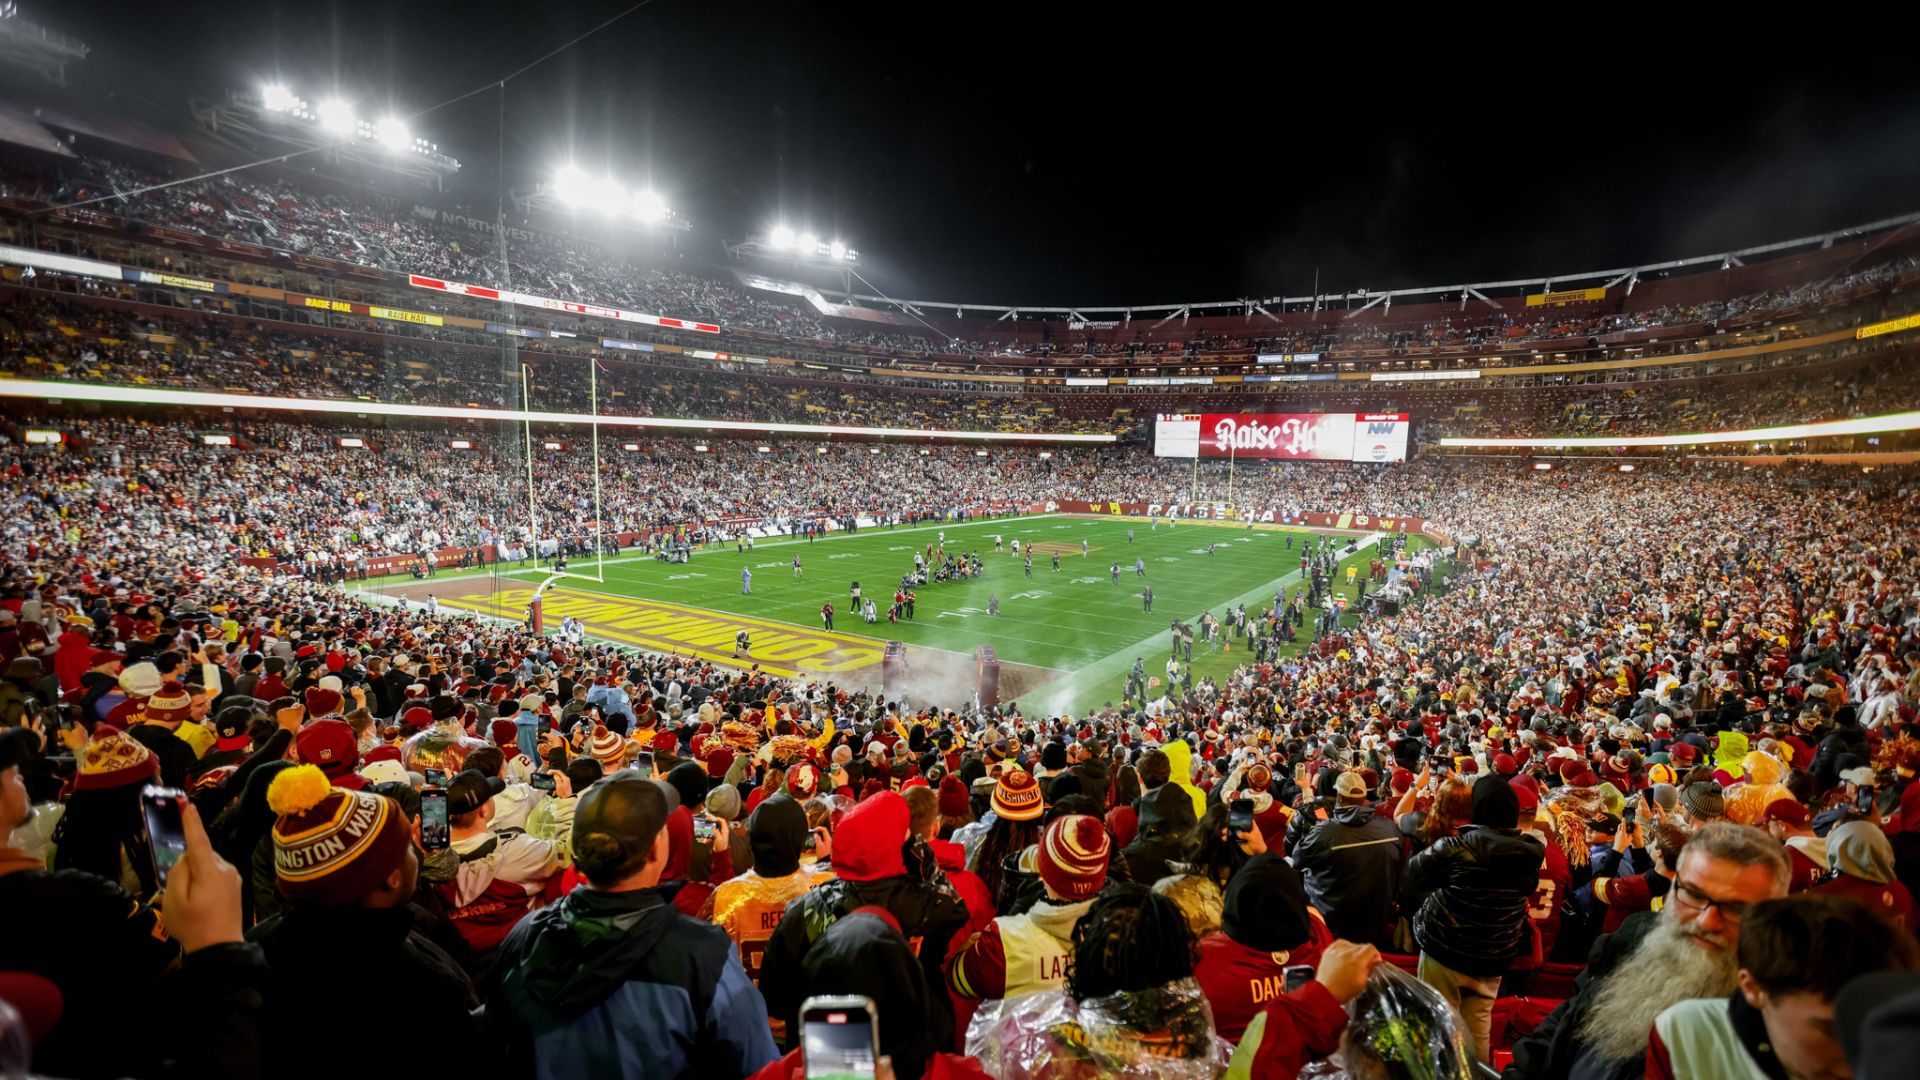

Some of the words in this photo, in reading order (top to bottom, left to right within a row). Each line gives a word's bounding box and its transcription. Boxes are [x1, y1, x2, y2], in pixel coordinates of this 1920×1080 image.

[442, 211, 535, 243] NORTHWEST
[538, 234, 601, 255] STADIUM
[305, 297, 330, 309] RAISE
[332, 301, 352, 313] HAIL
[387, 310, 408, 321] RAISE
[410, 314, 427, 324] HAIL
[1215, 418, 1281, 452] Raise
[1368, 423, 1395, 435] NW
[1089, 504, 1101, 512] W
[366, 561, 392, 571] TIME
[398, 557, 427, 567] WORL
[890, 776, 901, 793] 5
[1527, 878, 1556, 919] 3
